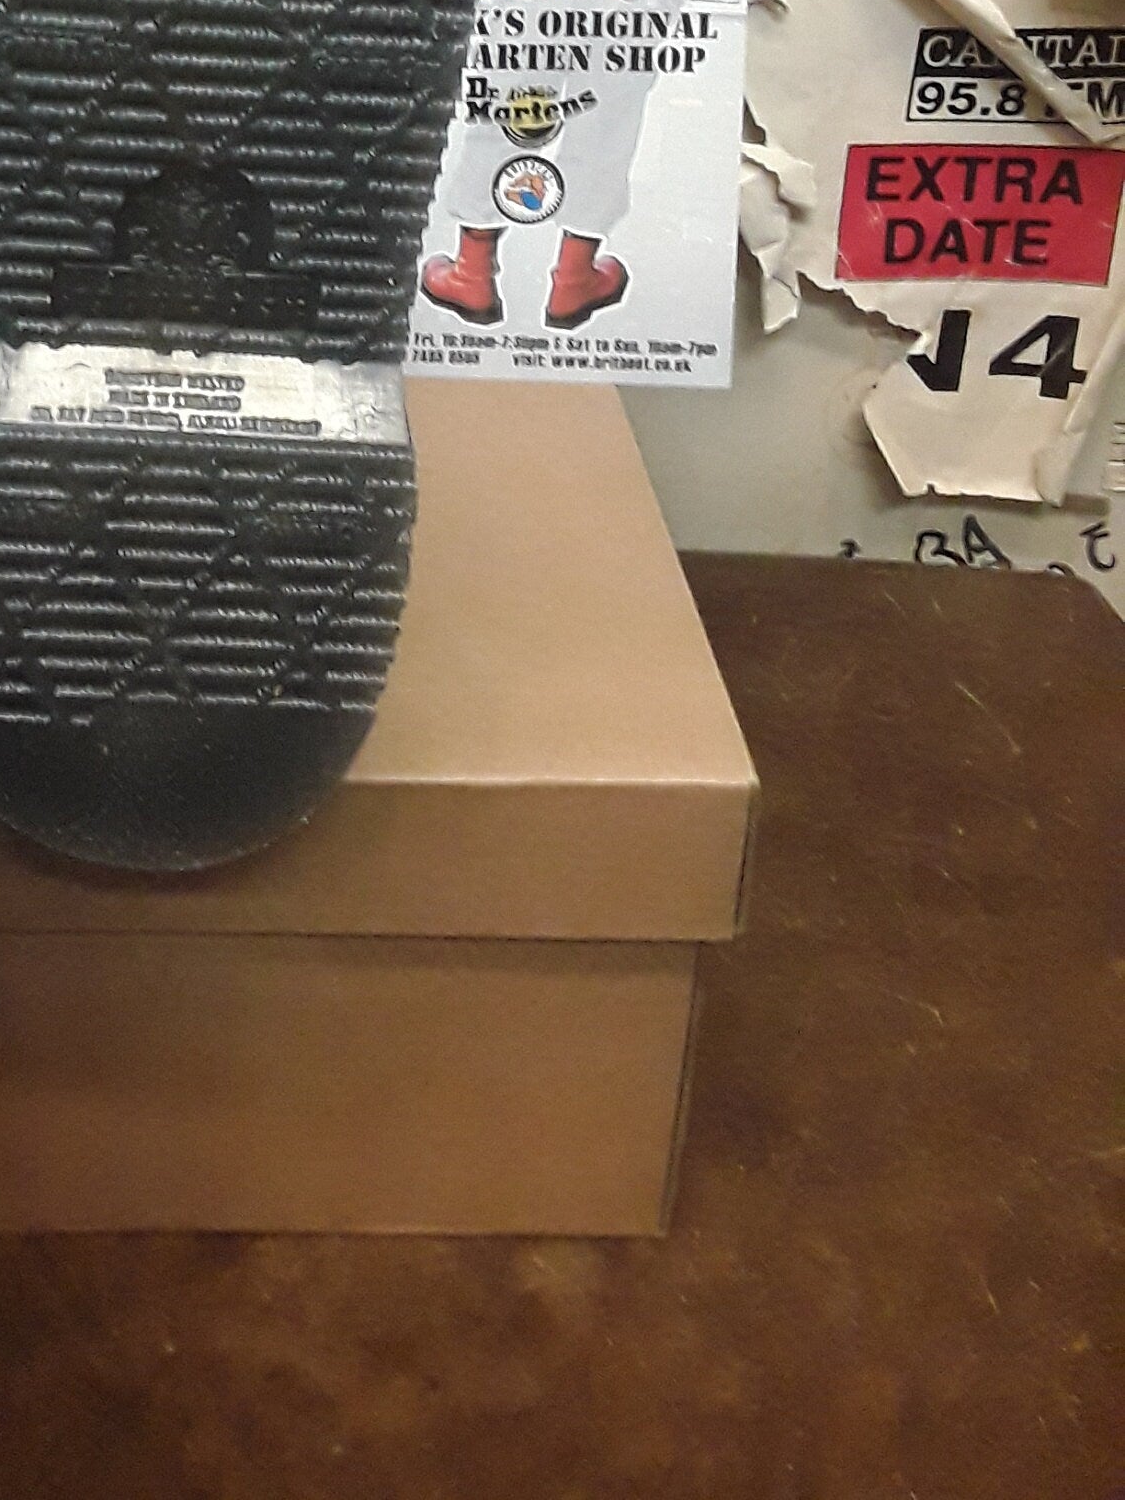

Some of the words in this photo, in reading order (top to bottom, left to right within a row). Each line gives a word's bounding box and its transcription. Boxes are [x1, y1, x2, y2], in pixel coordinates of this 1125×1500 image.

[538, 10, 718, 40] ORIGINAL
[605, 45, 706, 73] SHOP
[466, 88, 599, 125] Martens
[915, 81, 1026, 117] 95.8
[866, 156, 1083, 205] EXTRA
[883, 218, 1052, 265] DATE
[596, 339, 609, 352] to
